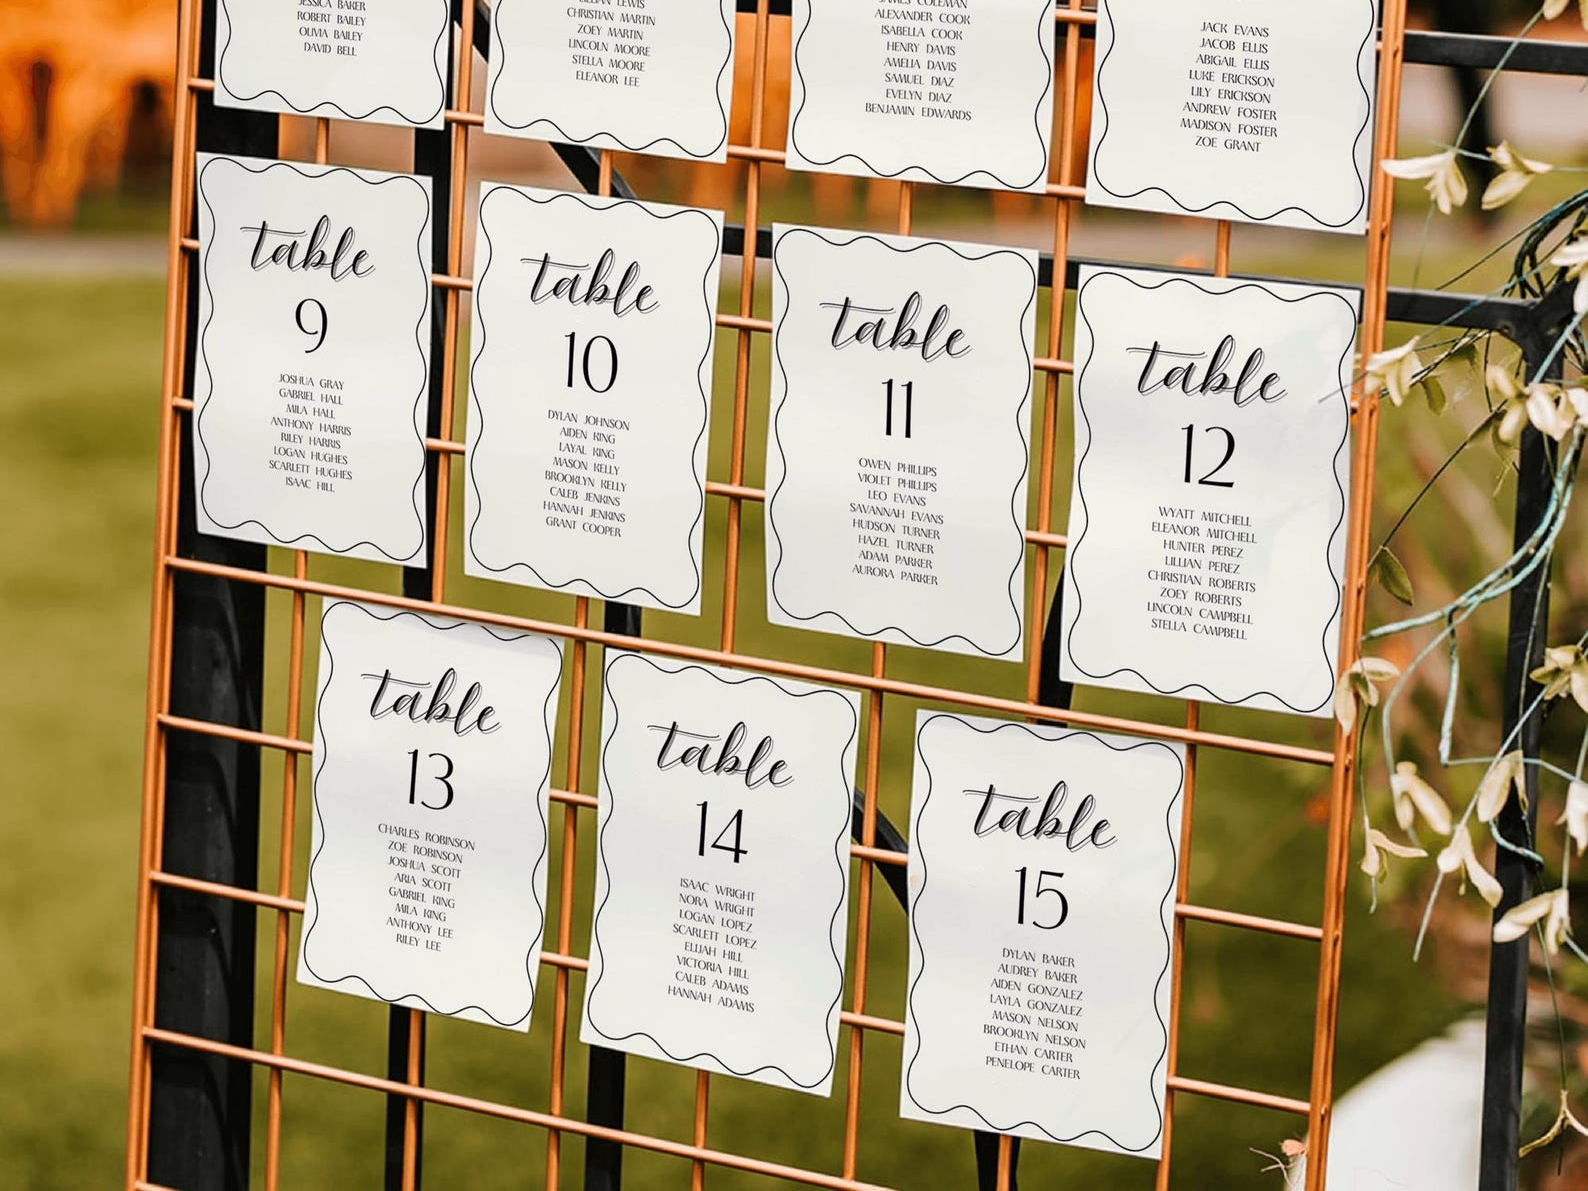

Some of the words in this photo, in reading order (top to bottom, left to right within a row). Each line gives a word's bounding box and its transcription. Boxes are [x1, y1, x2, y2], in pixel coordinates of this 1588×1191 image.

[1201, 21, 1228, 34] JACK
[1234, 24, 1269, 38] EVANS
[304, 42, 332, 53] DAVID
[337, 45, 357, 56] BELL
[568, 38, 608, 52] LINCOLN
[614, 43, 650, 57] MOORE
[886, 41, 920, 53] HENRY
[926, 44, 956, 56] DAVIS
[1196, 54, 1237, 68] ABIGAIL
[1244, 58, 1270, 71] ELLIS
[576, 70, 618, 84] ELEANOR
[624, 76, 639, 87] LEE
[865, 102, 915, 116] BENJAMIN
[921, 107, 972, 121] EDWARDS
[1182, 101, 1231, 116] ANDREW
[1237, 107, 1277, 121] FOSTER
[1195, 136, 1217, 148] ZOE
[1224, 139, 1261, 152] GRANT
[240, 215, 375, 282] table
[520, 248, 660, 318] table
[295, 298, 327, 353] 9
[819, 291, 972, 363] table
[565, 330, 618, 393] 10
[1126, 335, 1288, 408] table
[279, 373, 314, 387] JOSHUA
[319, 379, 344, 390] GRAY
[286, 404, 308, 415] MILA
[313, 407, 335, 419] HALL
[882, 378, 912, 438] 11
[548, 409, 578, 423] DYLAN
[584, 415, 629, 431] JOHNSON
[274, 446, 305, 459] LOGAN
[311, 451, 348, 465] HUGHES
[553, 456, 588, 471] MASON
[593, 463, 620, 476] KELLY
[1181, 424, 1235, 488] 12
[859, 458, 891, 471] OWEN
[897, 462, 937, 477] PHILLIPS
[286, 477, 311, 489] ISAAC
[317, 481, 335, 492] HILL
[868, 489, 887, 501] LEO
[894, 493, 926, 506] EVANS
[546, 516, 576, 529] GRANT
[582, 522, 621, 537] COOPER
[1158, 506, 1194, 520] WYATT
[1201, 511, 1252, 527] MITCHELL
[858, 534, 889, 547] HAZEL
[896, 540, 934, 554] TURNER
[852, 564, 895, 579] AURORA
[901, 571, 938, 585] PARKER
[1165, 556, 1202, 569] LILLIAN
[1208, 561, 1240, 574] PEREZ
[1151, 618, 1187, 632] STELLA
[1193, 624, 1247, 640] CAMPBELL
[360, 668, 501, 737] table
[647, 721, 794, 790] table
[408, 749, 453, 810] 13
[963, 780, 1118, 853] table
[378, 823, 420, 840] CHARLES
[425, 832, 475, 851] ROBINSON
[697, 800, 748, 863] 14
[388, 856, 426, 872] JOSHUA
[431, 864, 461, 879] SCOTT
[680, 878, 709, 892] ISAAC
[715, 884, 755, 902] WRIGHT
[1015, 865, 1068, 929] 15
[395, 903, 418, 916] MILA
[423, 909, 446, 922] KING
[396, 933, 420, 947] RILEY
[426, 940, 441, 952] LEE
[673, 923, 719, 941] SCARLETT
[726, 934, 757, 949] LOPEZ
[1002, 947, 1036, 962] DYLAN
[1042, 954, 1075, 968] BAKER
[668, 985, 712, 1003] HANNAH
[718, 996, 754, 1013] ADAMS
[991, 978, 1021, 992] AIDEN
[1027, 983, 1083, 1001] GONZALEZ
[983, 1024, 1039, 1042] BROOKLYN
[1045, 1033, 1086, 1049] NELSON
[986, 1056, 1035, 1072] PENELOPE
[1041, 1065, 1080, 1080] CARTER
